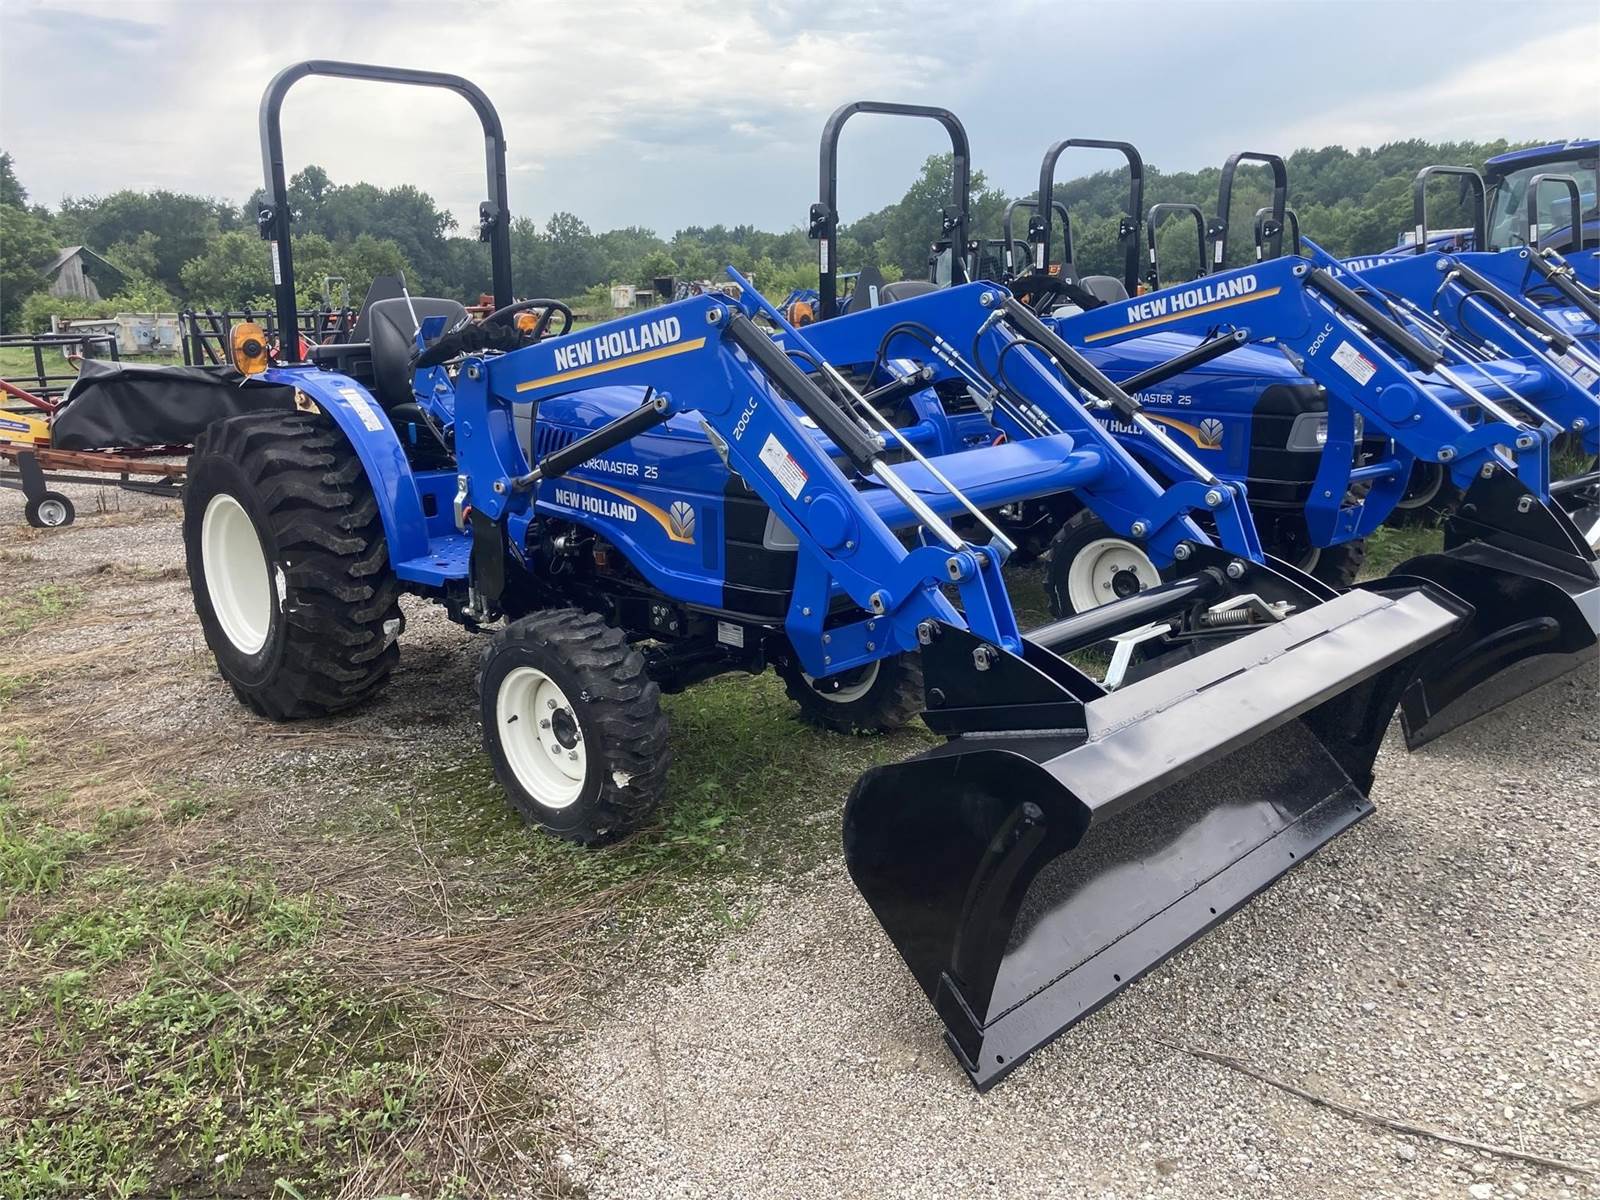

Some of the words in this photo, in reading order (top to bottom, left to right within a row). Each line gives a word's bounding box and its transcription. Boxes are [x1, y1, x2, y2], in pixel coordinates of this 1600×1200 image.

[1127, 298, 1167, 323] NEW
[1170, 274, 1257, 312] HOLLAND
[554, 340, 593, 371] NEW
[595, 316, 681, 361] HOLLAND
[1308, 322, 1334, 356] 200LC
[1178, 395, 1192, 405] 25
[732, 396, 758, 440] 200LC
[579, 458, 639, 476] ORKMASTER
[644, 465, 659, 479] 25
[555, 488, 580, 508] NEW
[581, 495, 637, 522] HOLLAND
